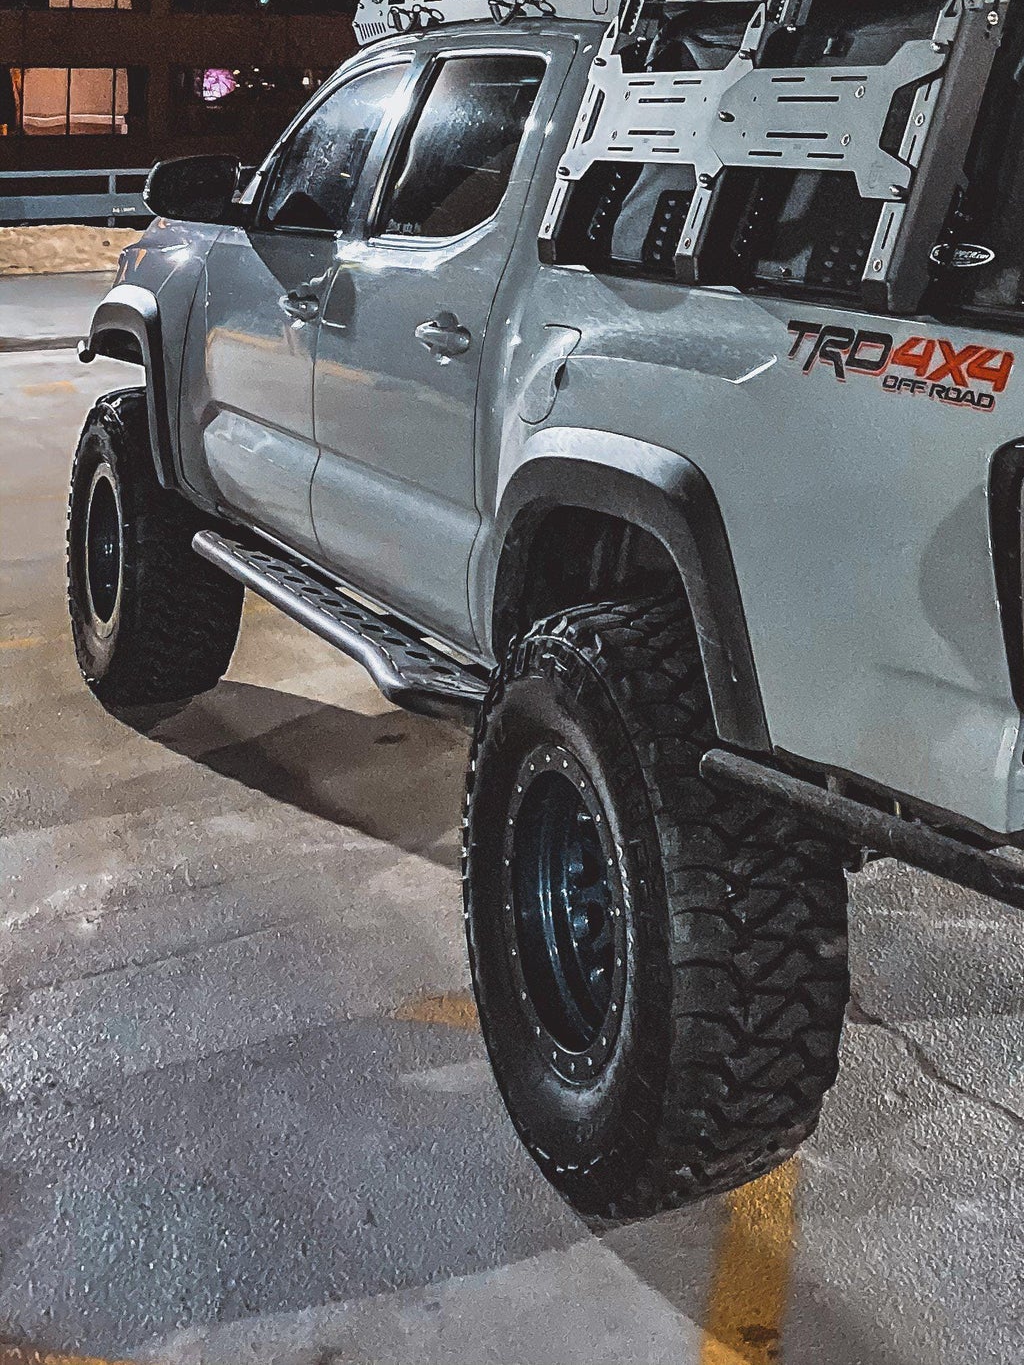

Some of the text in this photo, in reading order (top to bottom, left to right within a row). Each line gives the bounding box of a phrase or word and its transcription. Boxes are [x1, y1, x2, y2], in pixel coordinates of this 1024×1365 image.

[787, 320, 893, 383] TRD
[882, 374, 996, 413] OFF ROAD
